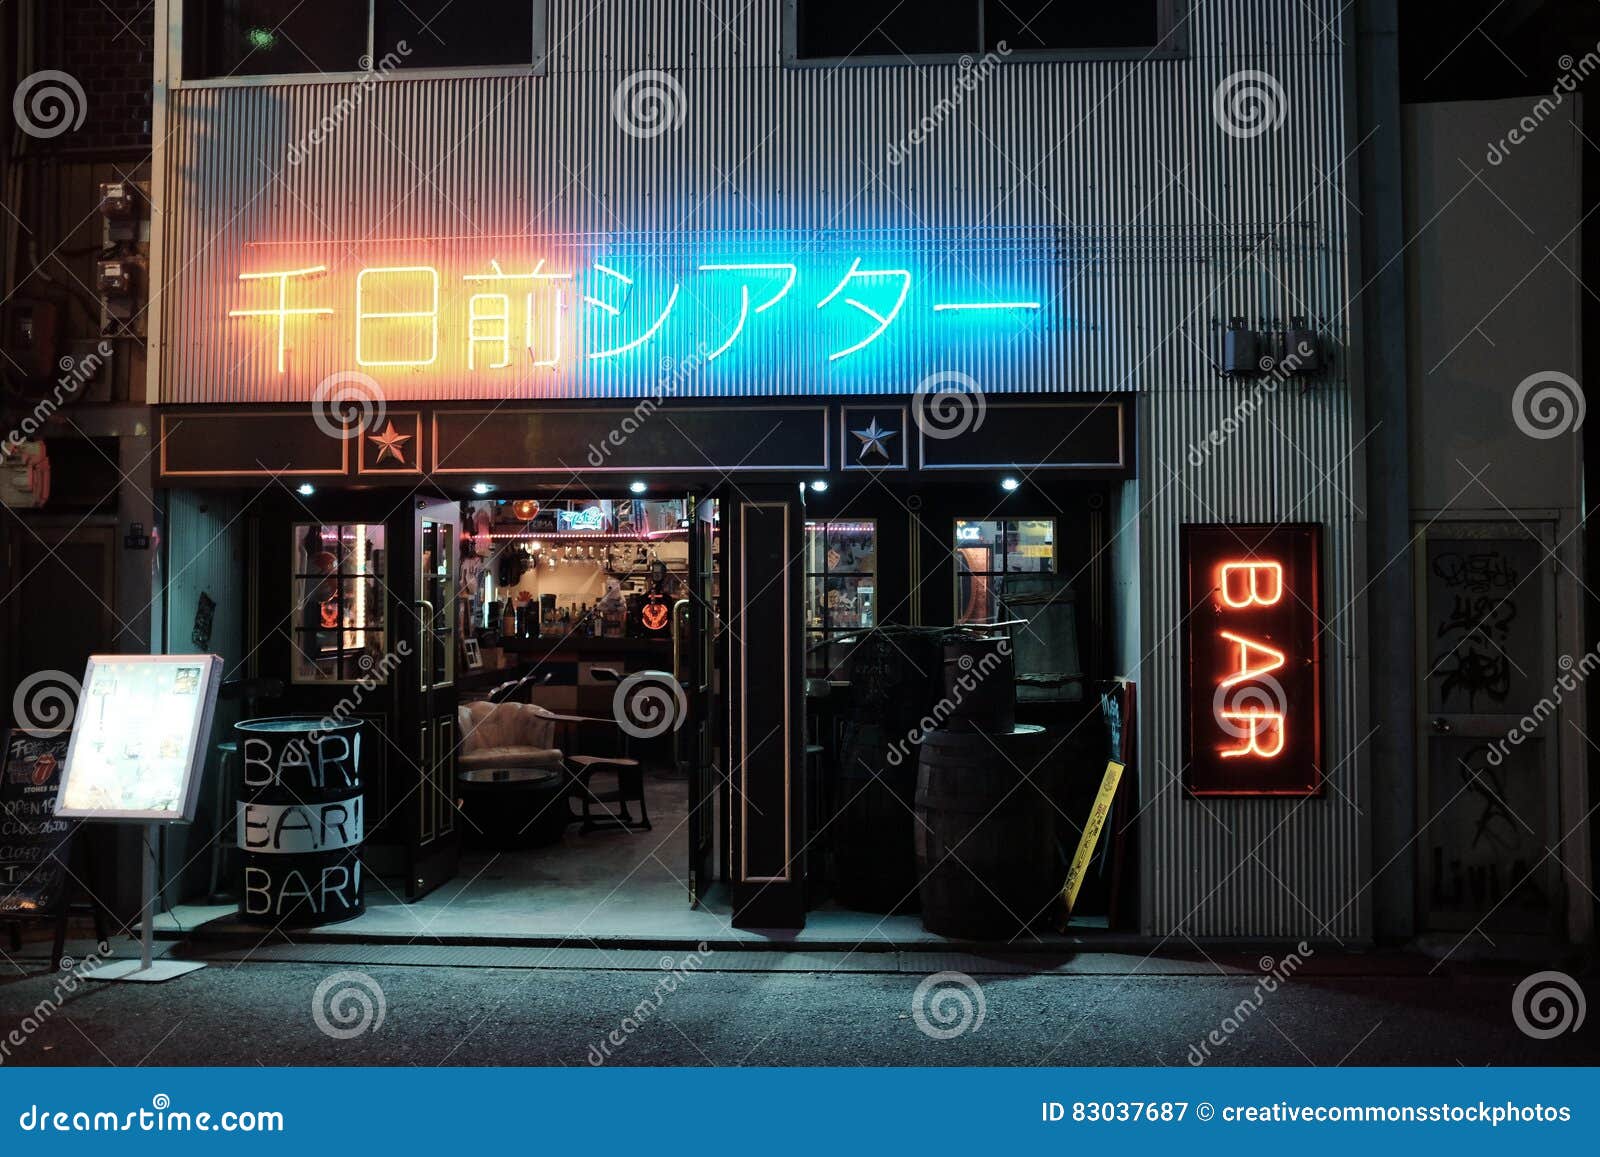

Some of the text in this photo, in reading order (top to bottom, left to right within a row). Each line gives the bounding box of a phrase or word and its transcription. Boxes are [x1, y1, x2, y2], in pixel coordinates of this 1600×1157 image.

[228, 257, 1042, 373] 千日前シアター
[1220, 561, 1285, 758] BAR
[244, 731, 361, 788] BAR!
[245, 860, 361, 916] BAR!
